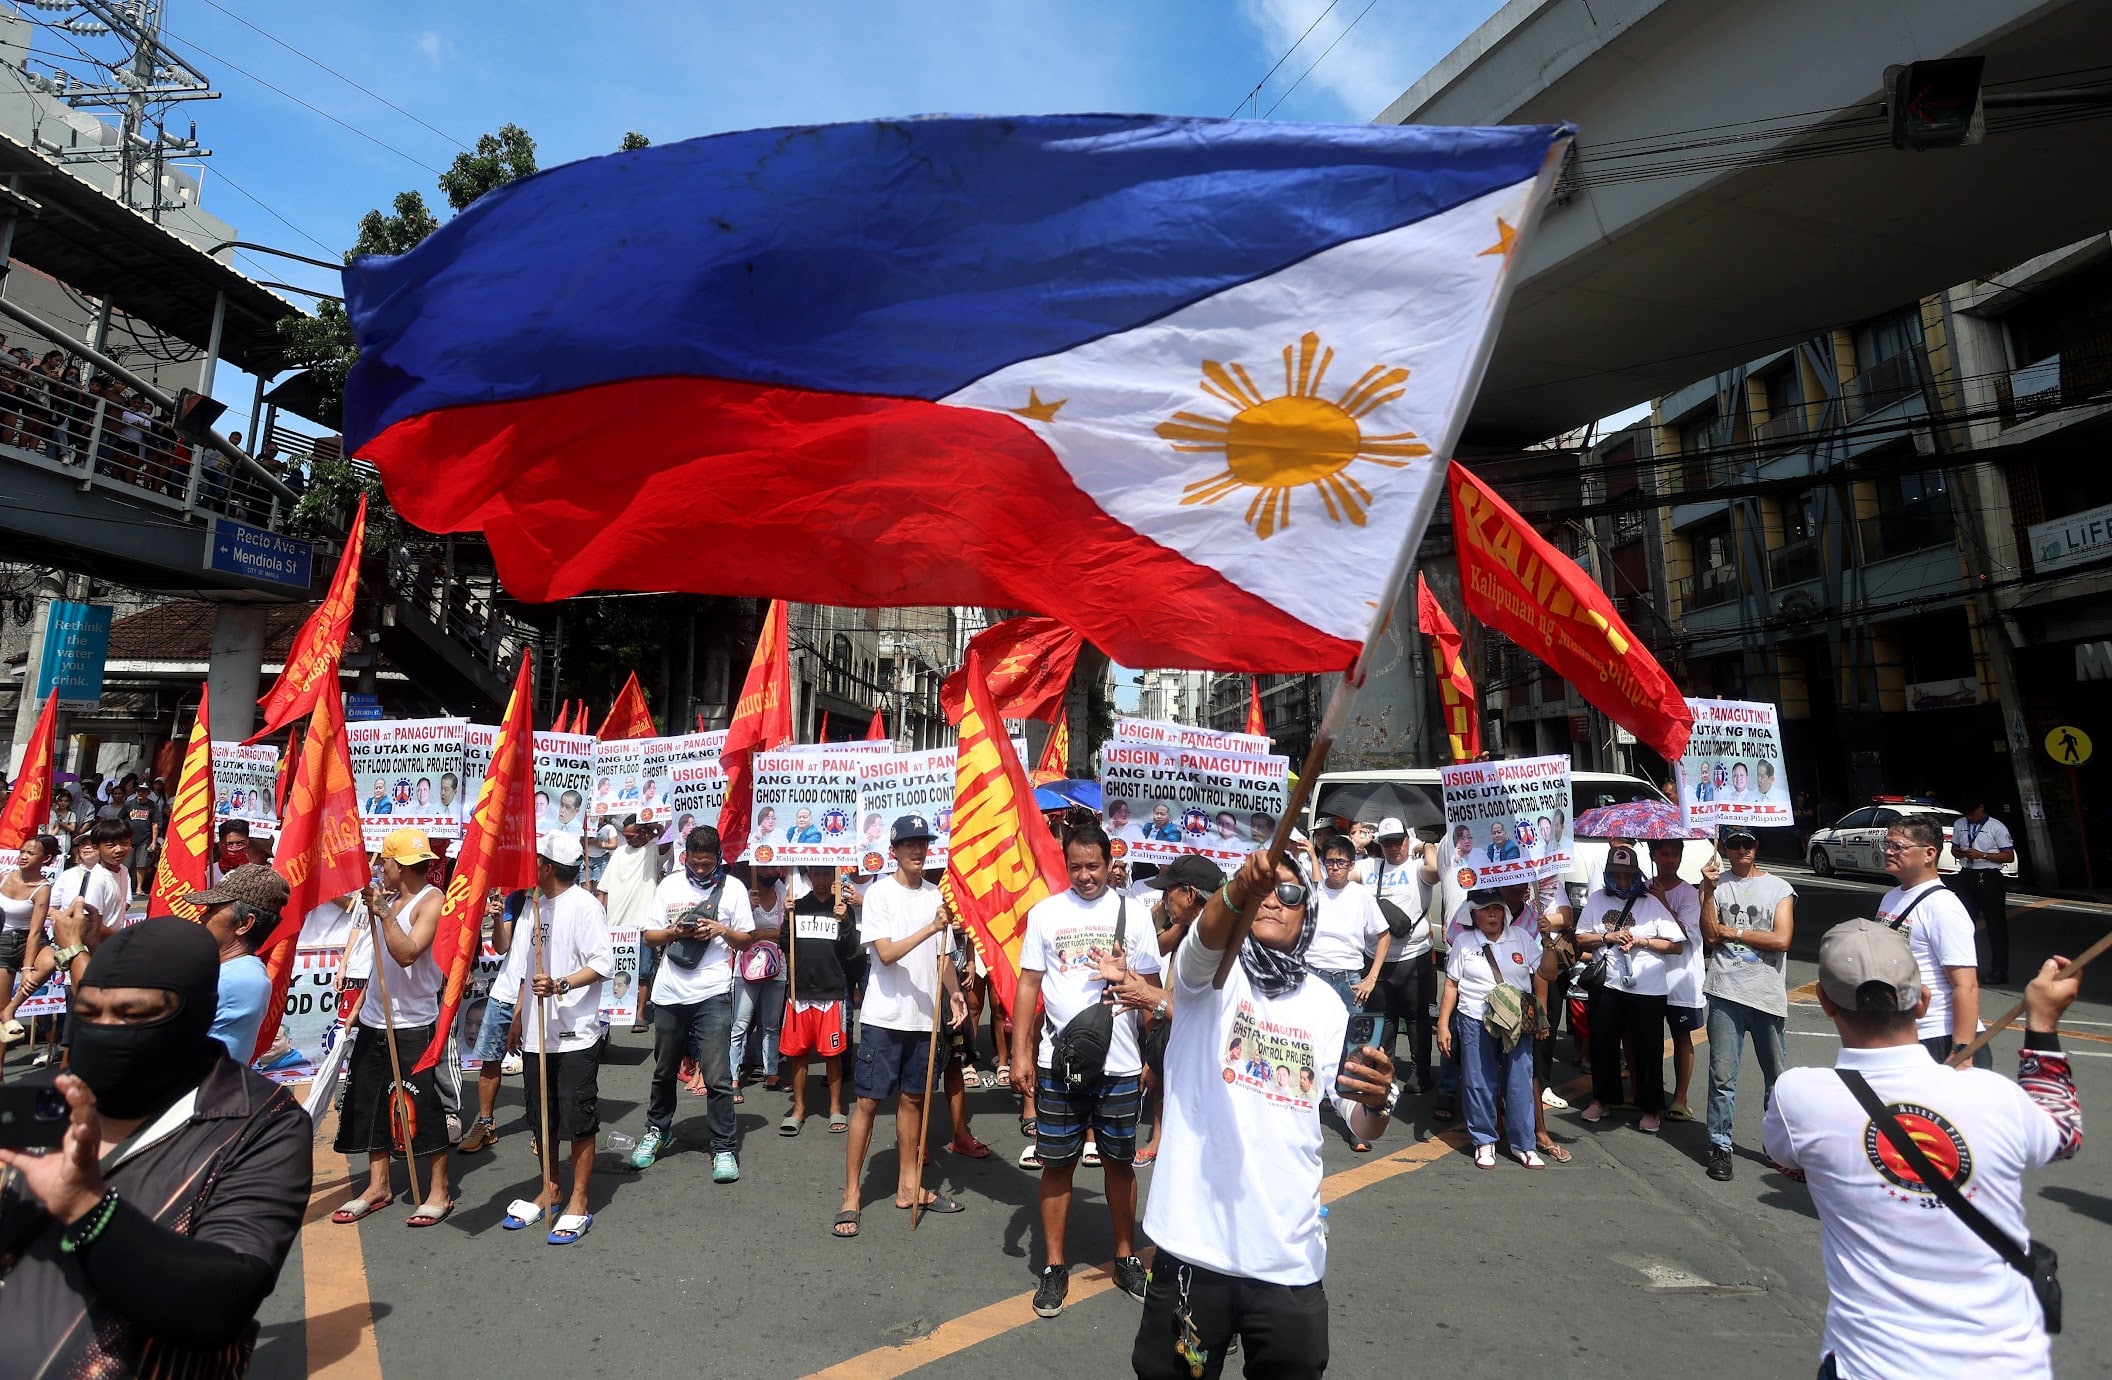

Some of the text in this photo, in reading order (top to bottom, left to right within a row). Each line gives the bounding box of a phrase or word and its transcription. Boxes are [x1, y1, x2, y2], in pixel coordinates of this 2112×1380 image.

[236, 527, 296, 554] Recto Ave
[232, 546, 297, 574] Mendiola St
[1470, 564, 1534, 628] Kalipunan
[1538, 614, 1556, 646] ng
[56, 619, 103, 632] Rethink
[67, 634, 87, 645] the
[57, 649, 94, 658] water
[62, 661, 84, 672] you
[52, 674, 88, 686] drink.
[1710, 706, 1771, 724] PANAGUTIN!!!
[383, 732, 392, 740] AT
[394, 725, 464, 740] PANAGUTIN!!!
[467, 731, 493, 746] IGIN
[1696, 724, 1773, 738] UTAK NG MGA
[1120, 723, 1264, 755] USIGIN AT PANAGUTIN!!!
[211, 746, 230, 757] SIGIN
[374, 744, 408, 754] UTAK
[412, 743, 430, 754] NG
[434, 742, 462, 753] MGA
[464, 750, 480, 758] NG
[533, 738, 592, 756] AGUTIN!!!
[597, 744, 630, 755] USIGIN
[644, 742, 673, 755] USIGIN
[1742, 742, 1778, 759] PROJECTS
[367, 758, 390, 774] FLOOD
[392, 758, 424, 773] CONTROL
[426, 756, 462, 772] PROJECTS
[556, 758, 590, 770] MGA
[597, 756, 621, 764] ANG
[644, 750, 714, 765] ANG UTAK NG
[1107, 748, 1283, 778] USIGIN AT PANAGUTIN!!!
[258, 764, 274, 774] MGA
[596, 764, 640, 776] GHOST FLOOD
[642, 766, 663, 778] GHOST
[758, 759, 804, 772] USIGIN
[808, 764, 818, 772] AT
[860, 760, 923, 779] USIGIN AT
[544, 771, 590, 790] PROJECTS
[672, 766, 718, 782] USIGIN
[757, 776, 856, 784] ANG UTAK N
[1106, 766, 1281, 793] ANG UTAK NG MGA
[1443, 761, 1566, 788] USIGIN AT PANAGUTIN!!!
[674, 782, 707, 794] ANG
[862, 772, 949, 792] ANG UTAK
[756, 788, 857, 804] GHOST FLOOD CONTRO
[1106, 781, 1282, 814] GHOST FLOOD CONTROL PROJECTS
[1446, 778, 1566, 802] ANG UTAK NG MGA
[674, 796, 705, 812] GHOST
[896, 789, 927, 808] FLOOD
[1448, 802, 1478, 823] GHOST
[1479, 800, 1505, 818] FLOOD
[1506, 796, 1540, 814] CONTROL
[1750, 815, 1788, 824] Pilipino
[1479, 853, 1571, 876] KAMPIL
[1480, 872, 1526, 884] Kalipunan
[1527, 870, 1537, 878] ng
[800, 920, 836, 934] STRIVE
[1056, 942, 1070, 950] GHOST
[830, 1032, 840, 1049] 6
[1270, 1036, 1288, 1046] NG
[1898, 1104, 1941, 1124] Masang
